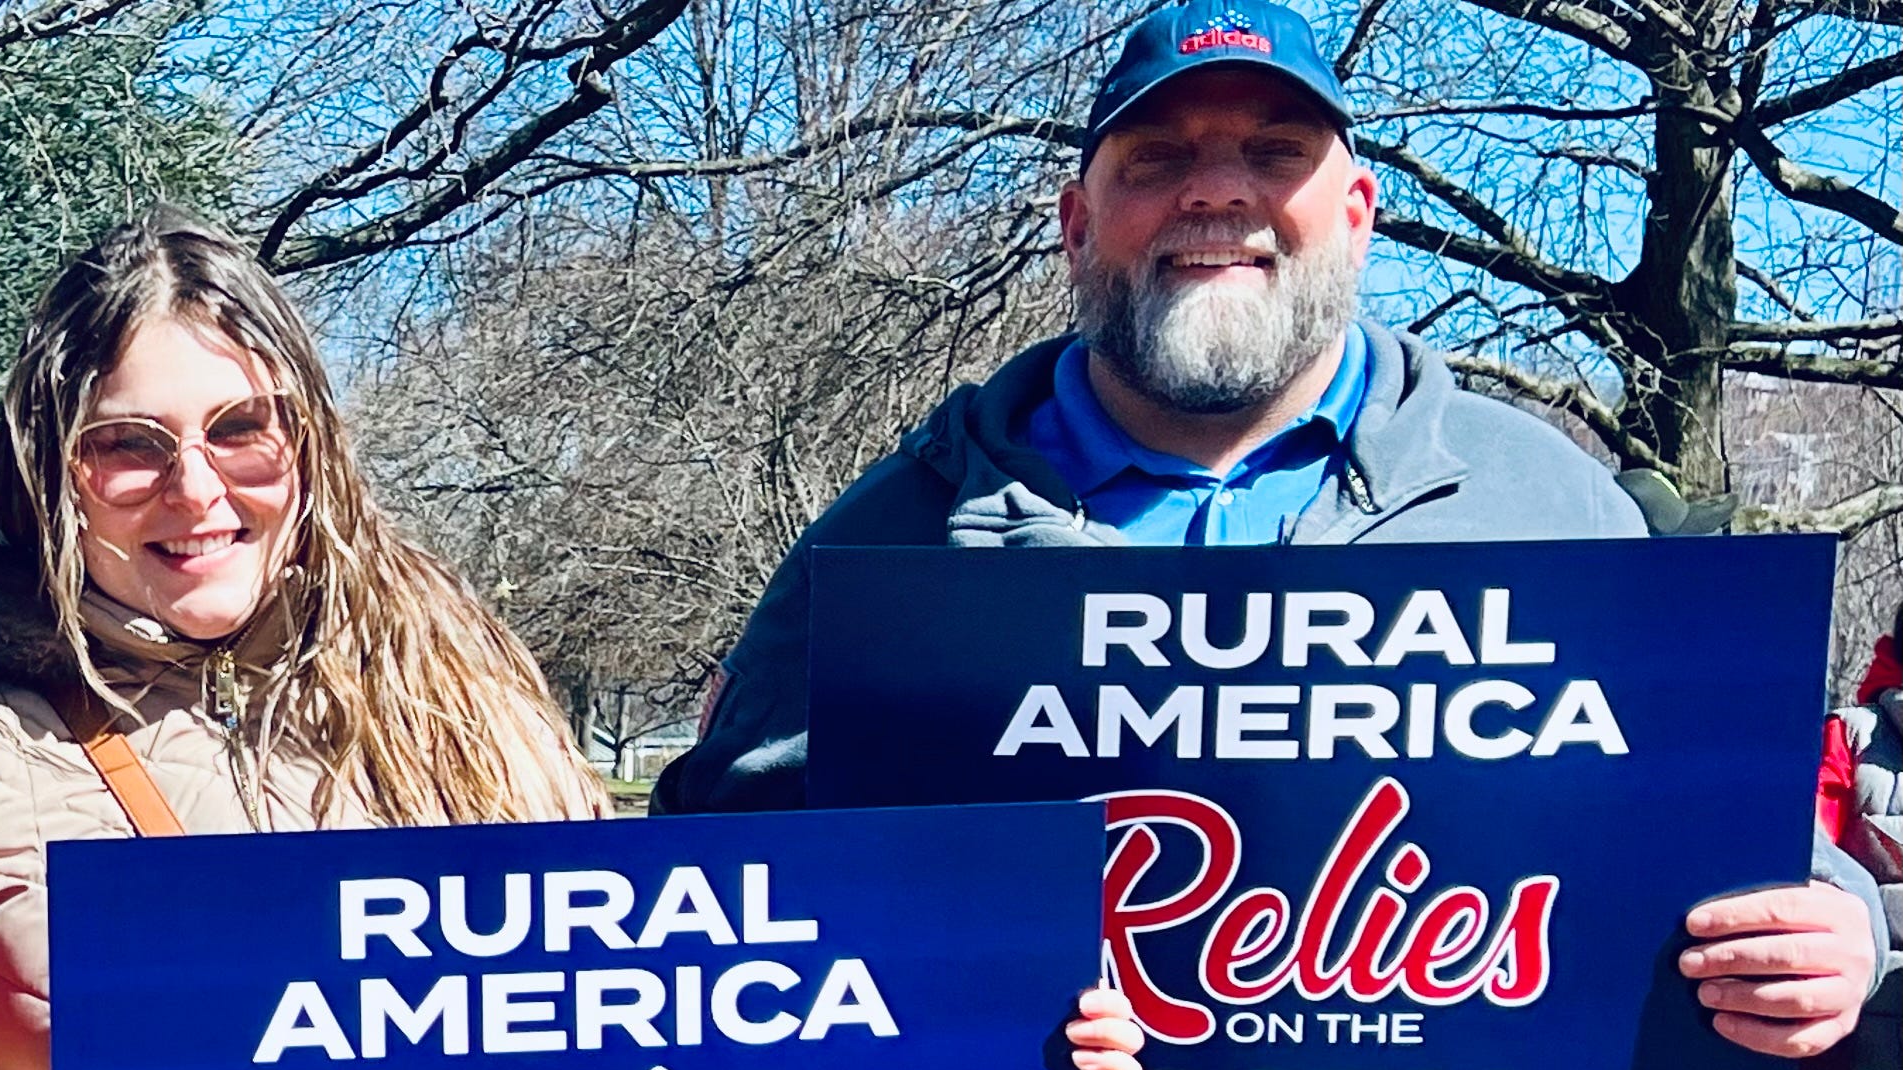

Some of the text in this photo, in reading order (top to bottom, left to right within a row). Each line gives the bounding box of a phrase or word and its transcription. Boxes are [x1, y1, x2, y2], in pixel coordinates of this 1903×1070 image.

[1082, 588, 1556, 669] RURAL
[993, 678, 1629, 760] AMERICA
[339, 863, 818, 962] RURAL
[1079, 775, 1561, 1046] Relies
[252, 958, 899, 1063] AMERICA
[1225, 1011, 1424, 1045] ON THE
